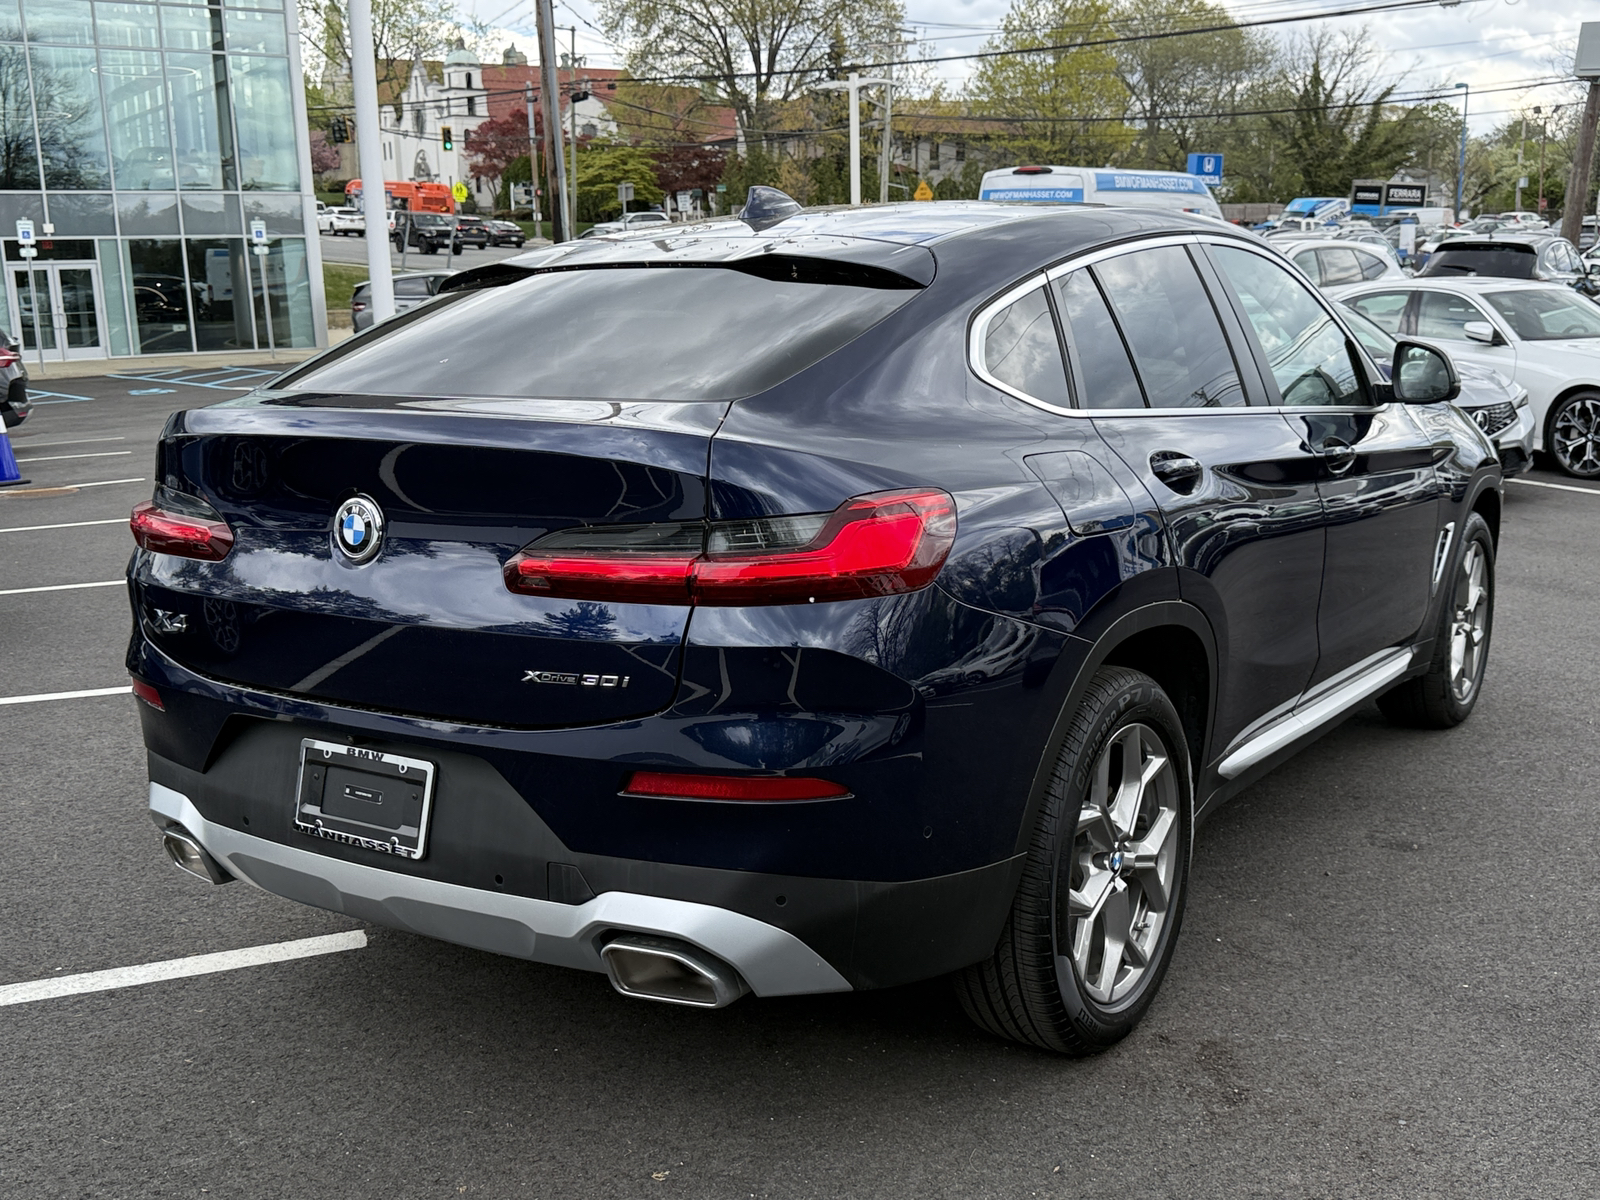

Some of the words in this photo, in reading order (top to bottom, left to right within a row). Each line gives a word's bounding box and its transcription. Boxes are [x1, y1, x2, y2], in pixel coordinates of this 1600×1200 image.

[1114, 175, 1194, 191] BMWOFMANHASSET.COM
[1198, 175, 1220, 185] ONDA
[341, 505, 371, 523] BMW
[153, 608, 189, 633] X4
[1075, 710, 1117, 792] Cinturato
[1118, 687, 1142, 712] P7
[347, 747, 384, 762] BMW
[295, 823, 416, 857] MANHASSET
